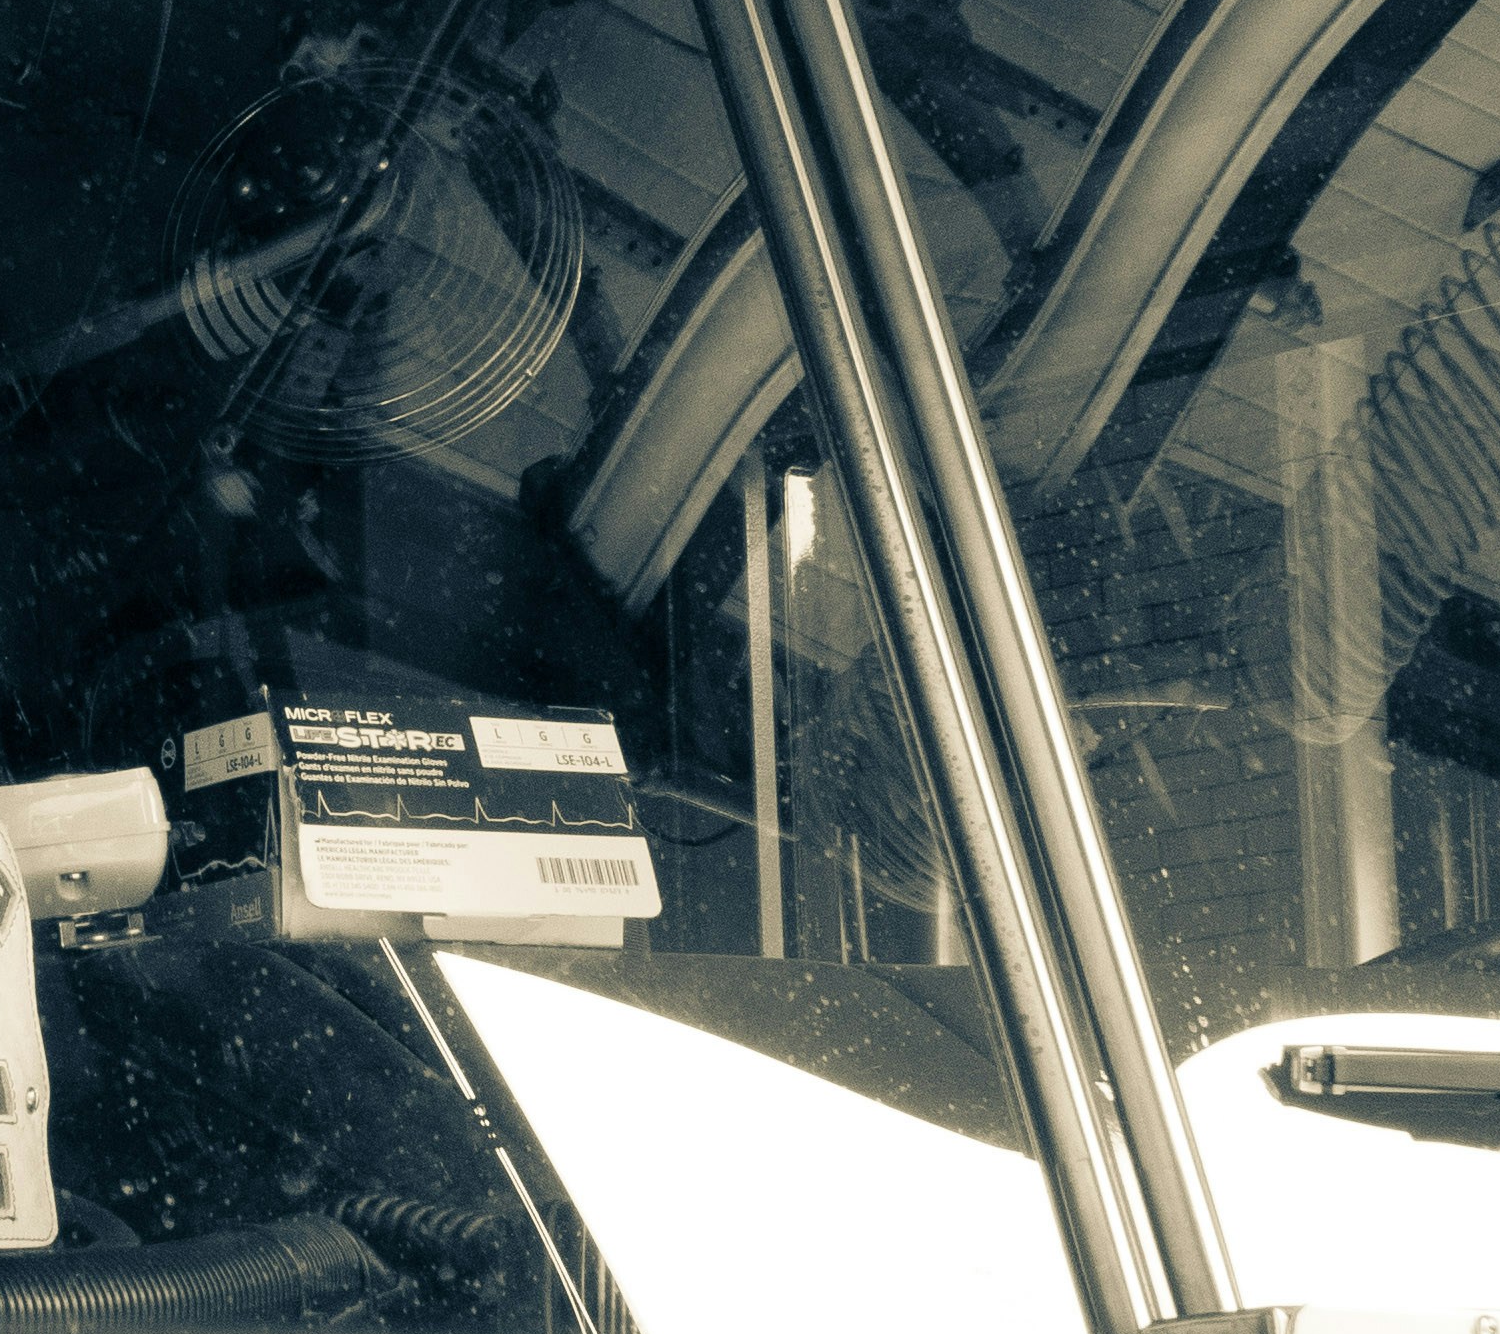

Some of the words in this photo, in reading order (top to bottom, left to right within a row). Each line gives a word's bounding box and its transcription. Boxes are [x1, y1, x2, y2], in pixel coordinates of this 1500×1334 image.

[494, 728, 502, 739] L
[539, 731, 548, 742] G
[583, 733, 592, 744] G
[226, 752, 263, 773] LSE-104-L
[296, 751, 347, 762] Powder-Free
[347, 754, 372, 763] Nitrile
[372, 755, 421, 765] Examination
[421, 757, 448, 767] Gloves
[555, 754, 613, 767] LSE-104-L
[298, 761, 321, 771] Gants
[361, 766, 372, 774] en
[372, 766, 396, 774] nitrile
[396, 768, 415, 776] sans
[415, 768, 444, 777] poudre
[300, 772, 333, 782] Guantes
[333, 774, 345, 783] de
[396, 777, 408, 786] de
[408, 777, 433, 786] Nitrilo
[433, 778, 447, 787] Sin
[447, 779, 470, 788] Polvo
[230, 896, 262, 922] Ansell
